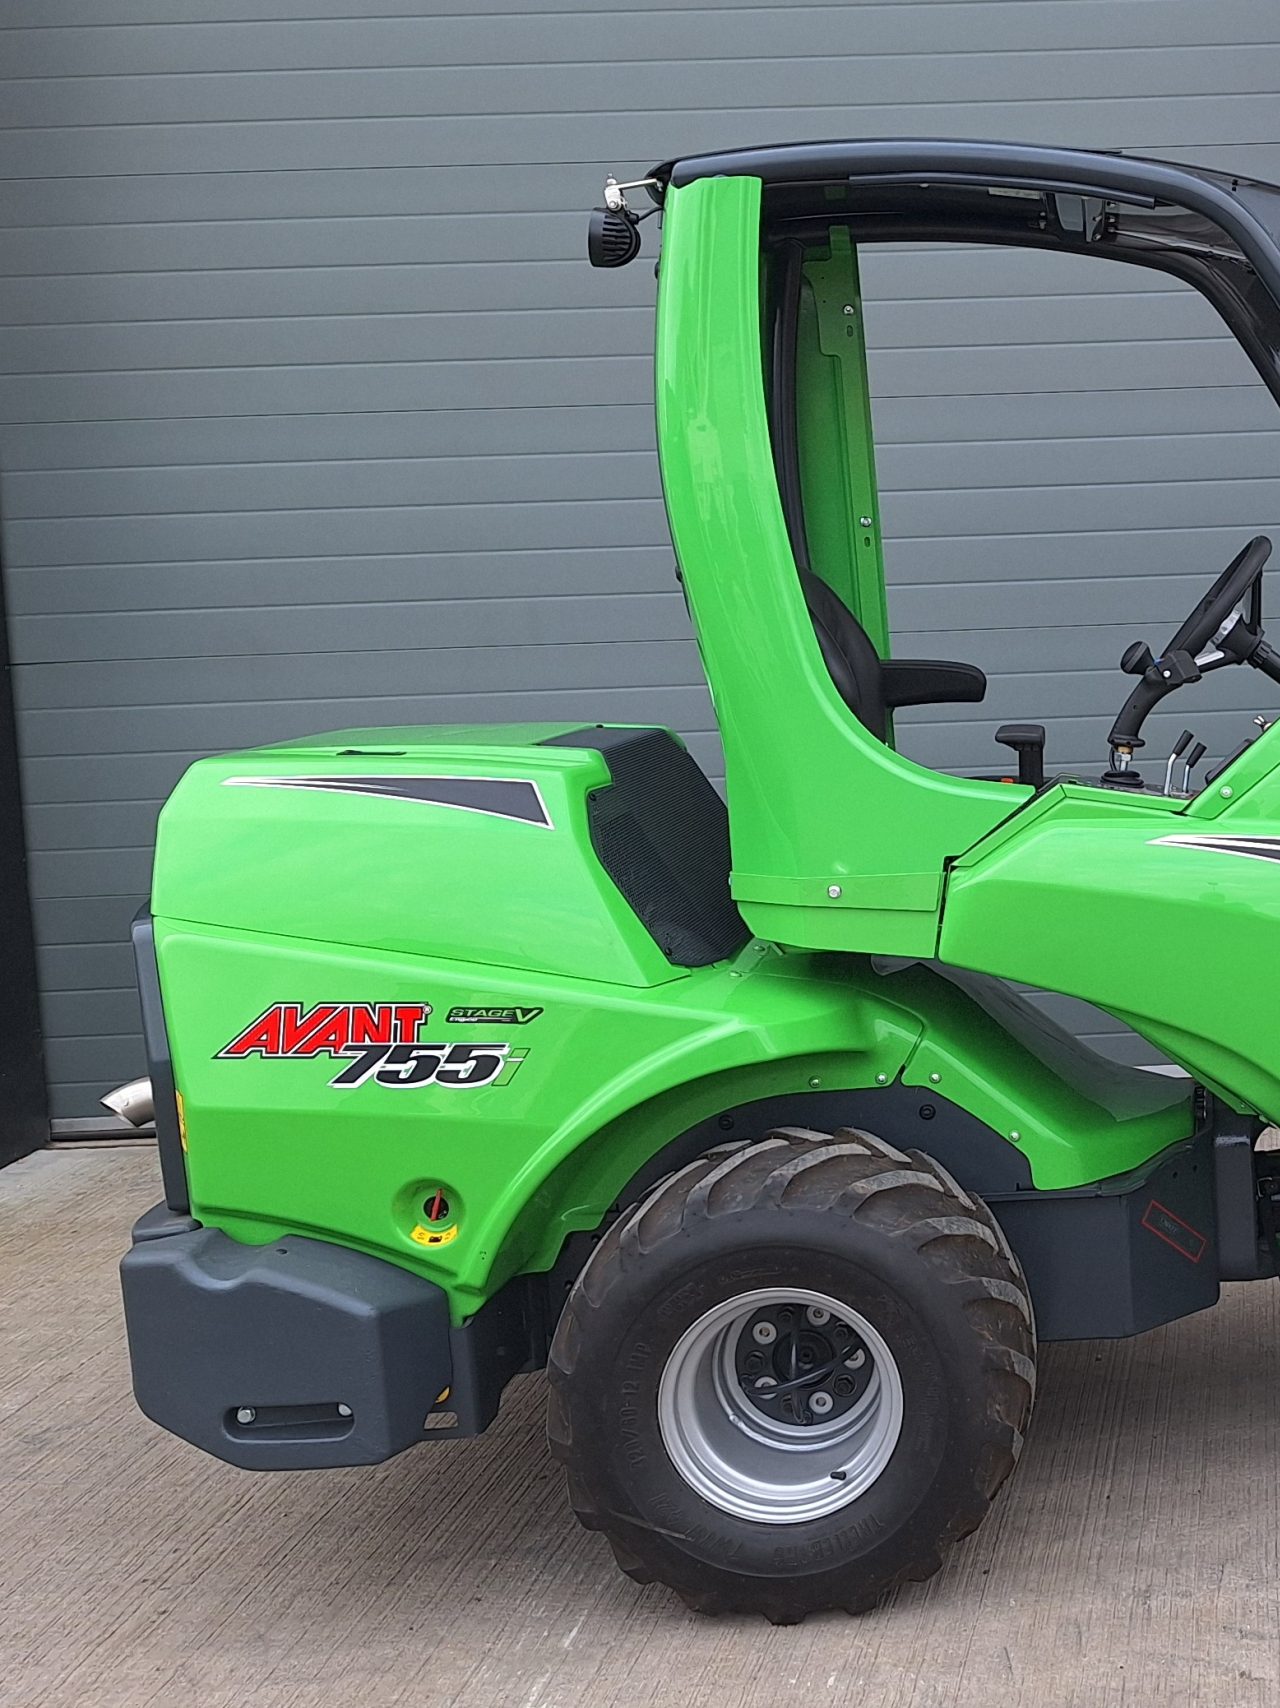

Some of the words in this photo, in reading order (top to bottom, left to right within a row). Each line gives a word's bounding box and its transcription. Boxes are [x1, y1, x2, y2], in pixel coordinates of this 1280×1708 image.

[213, 1001, 430, 1058] AVANT
[450, 1008, 514, 1017] STAGE
[515, 1008, 540, 1022] V
